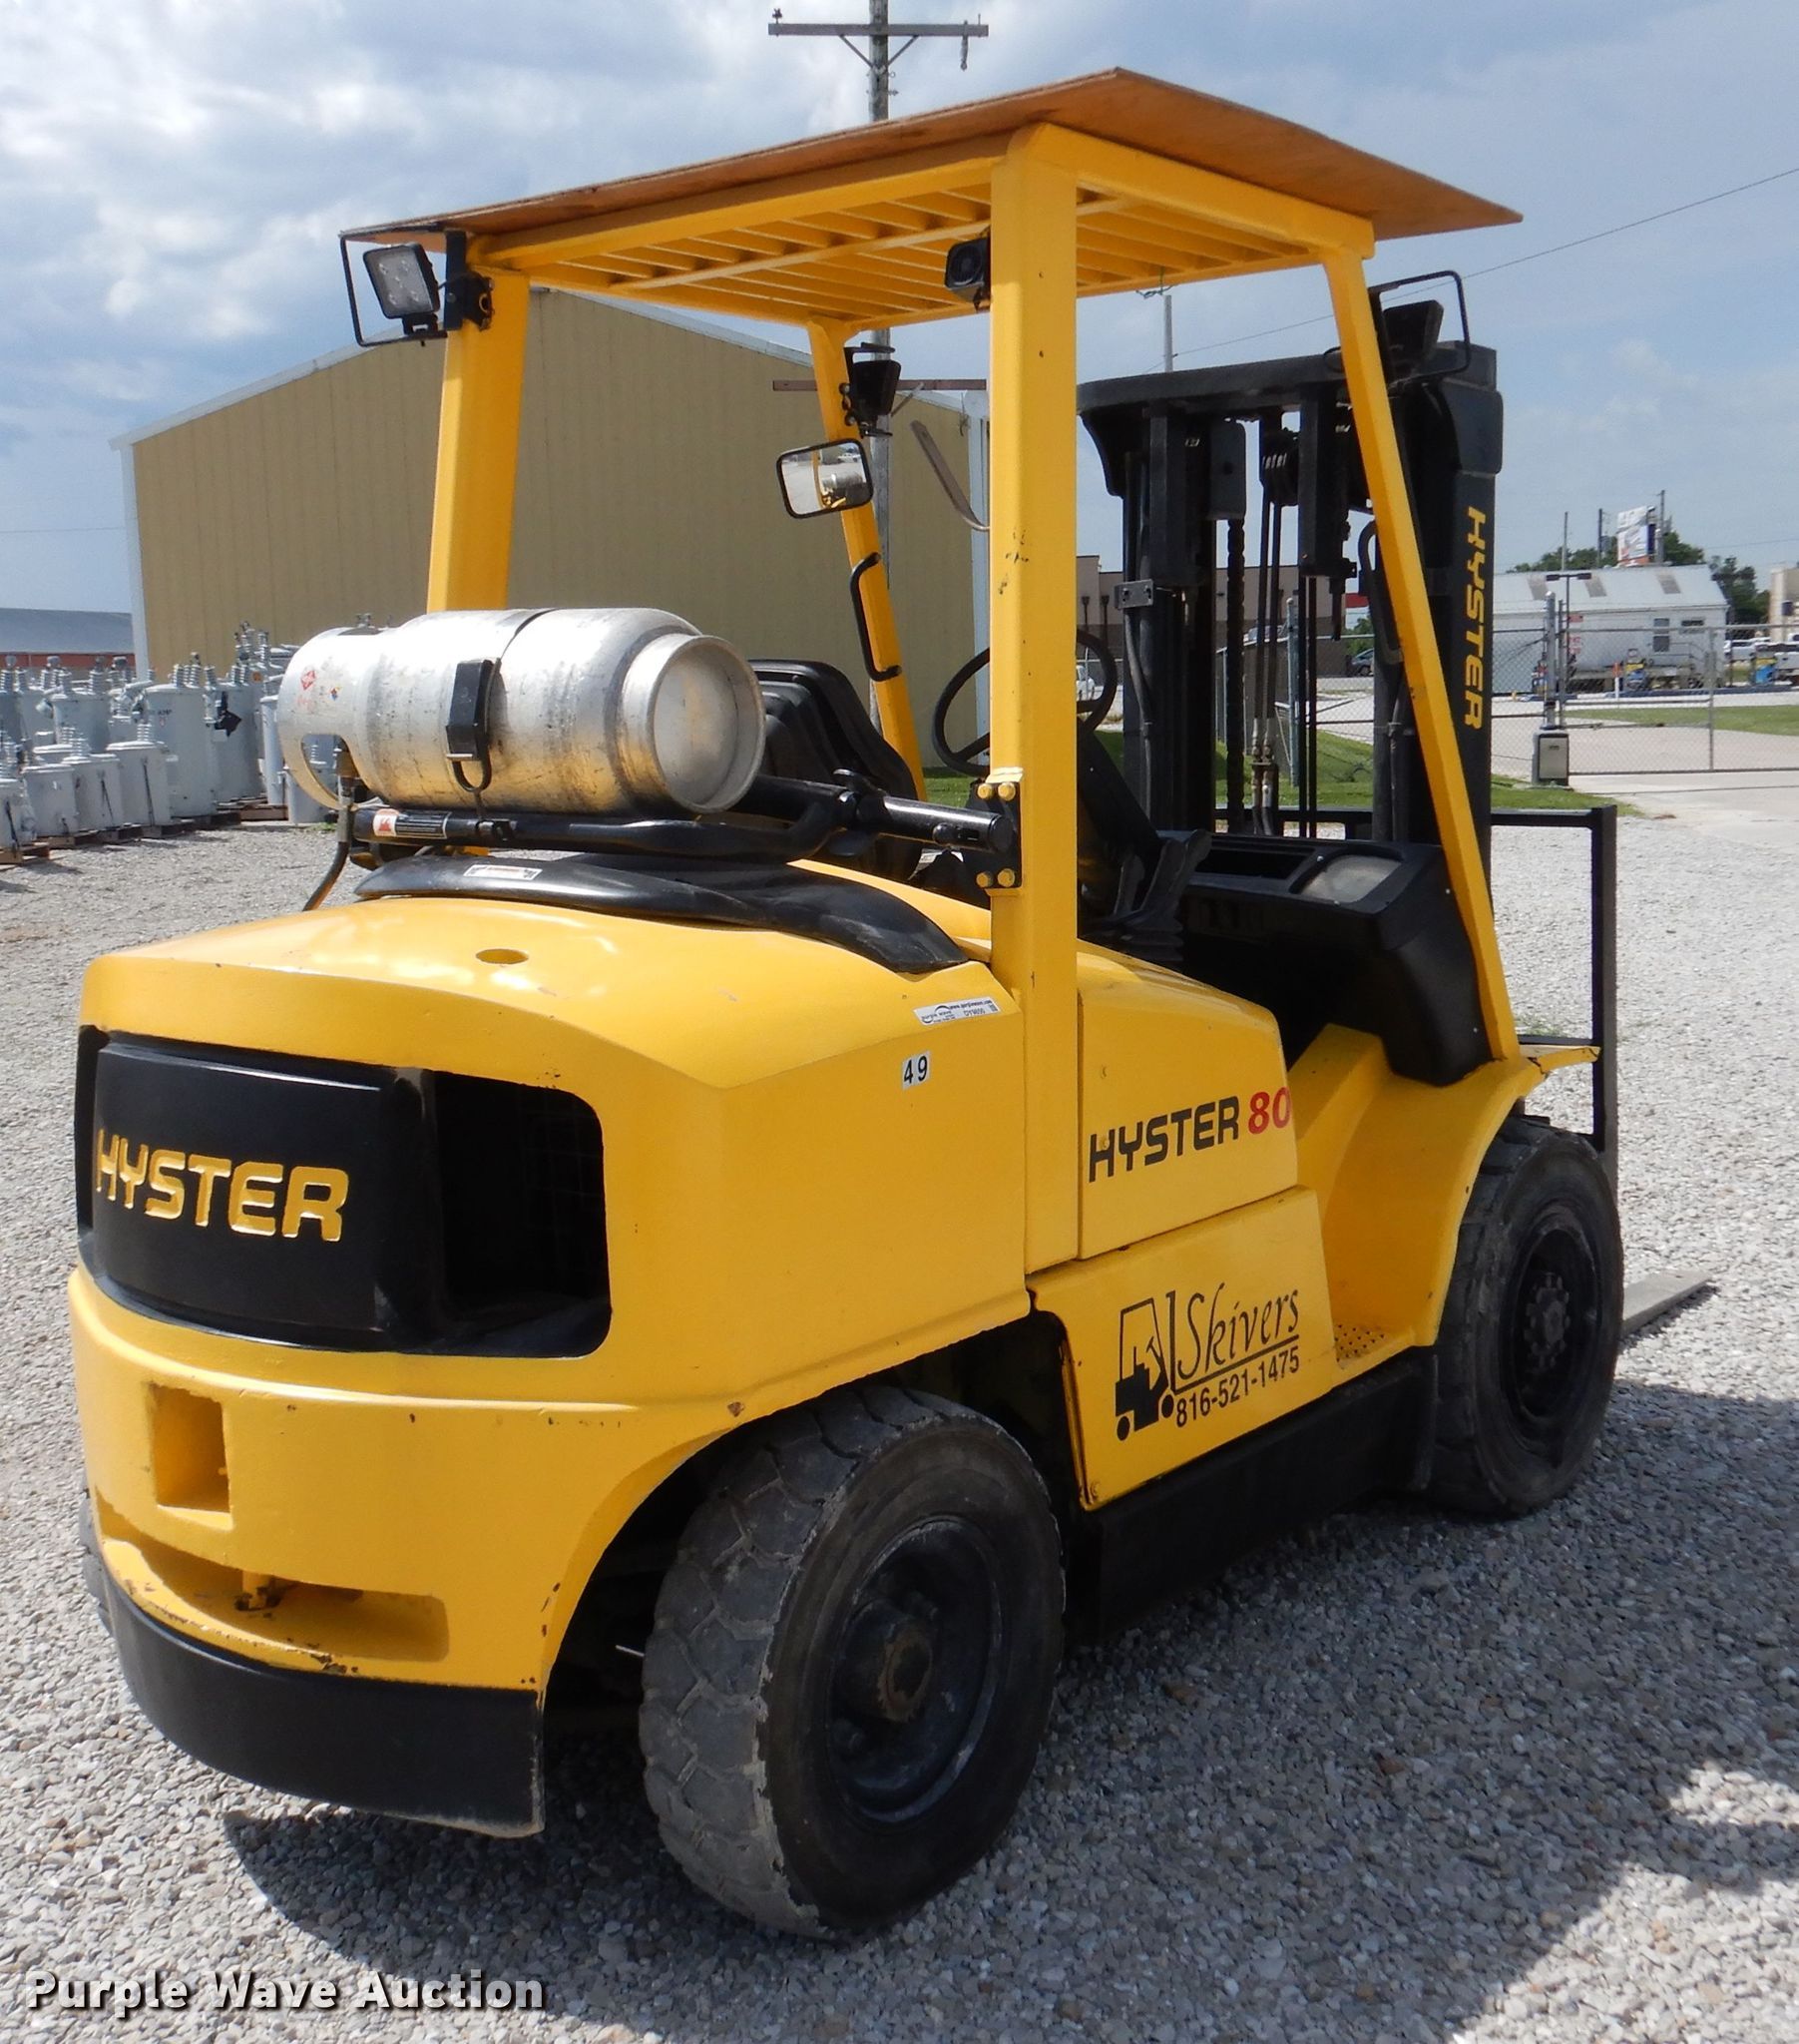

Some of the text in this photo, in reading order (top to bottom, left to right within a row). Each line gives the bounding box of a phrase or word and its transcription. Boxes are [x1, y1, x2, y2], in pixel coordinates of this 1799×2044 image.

[1465, 506, 1486, 729] HYSTER
[1089, 1086, 1292, 1183] HYSTER 80
[96, 1129, 349, 1243] HYSTER
[1177, 1281, 1299, 1380] Skivers
[1176, 1345, 1300, 1428] 816-521-1475
